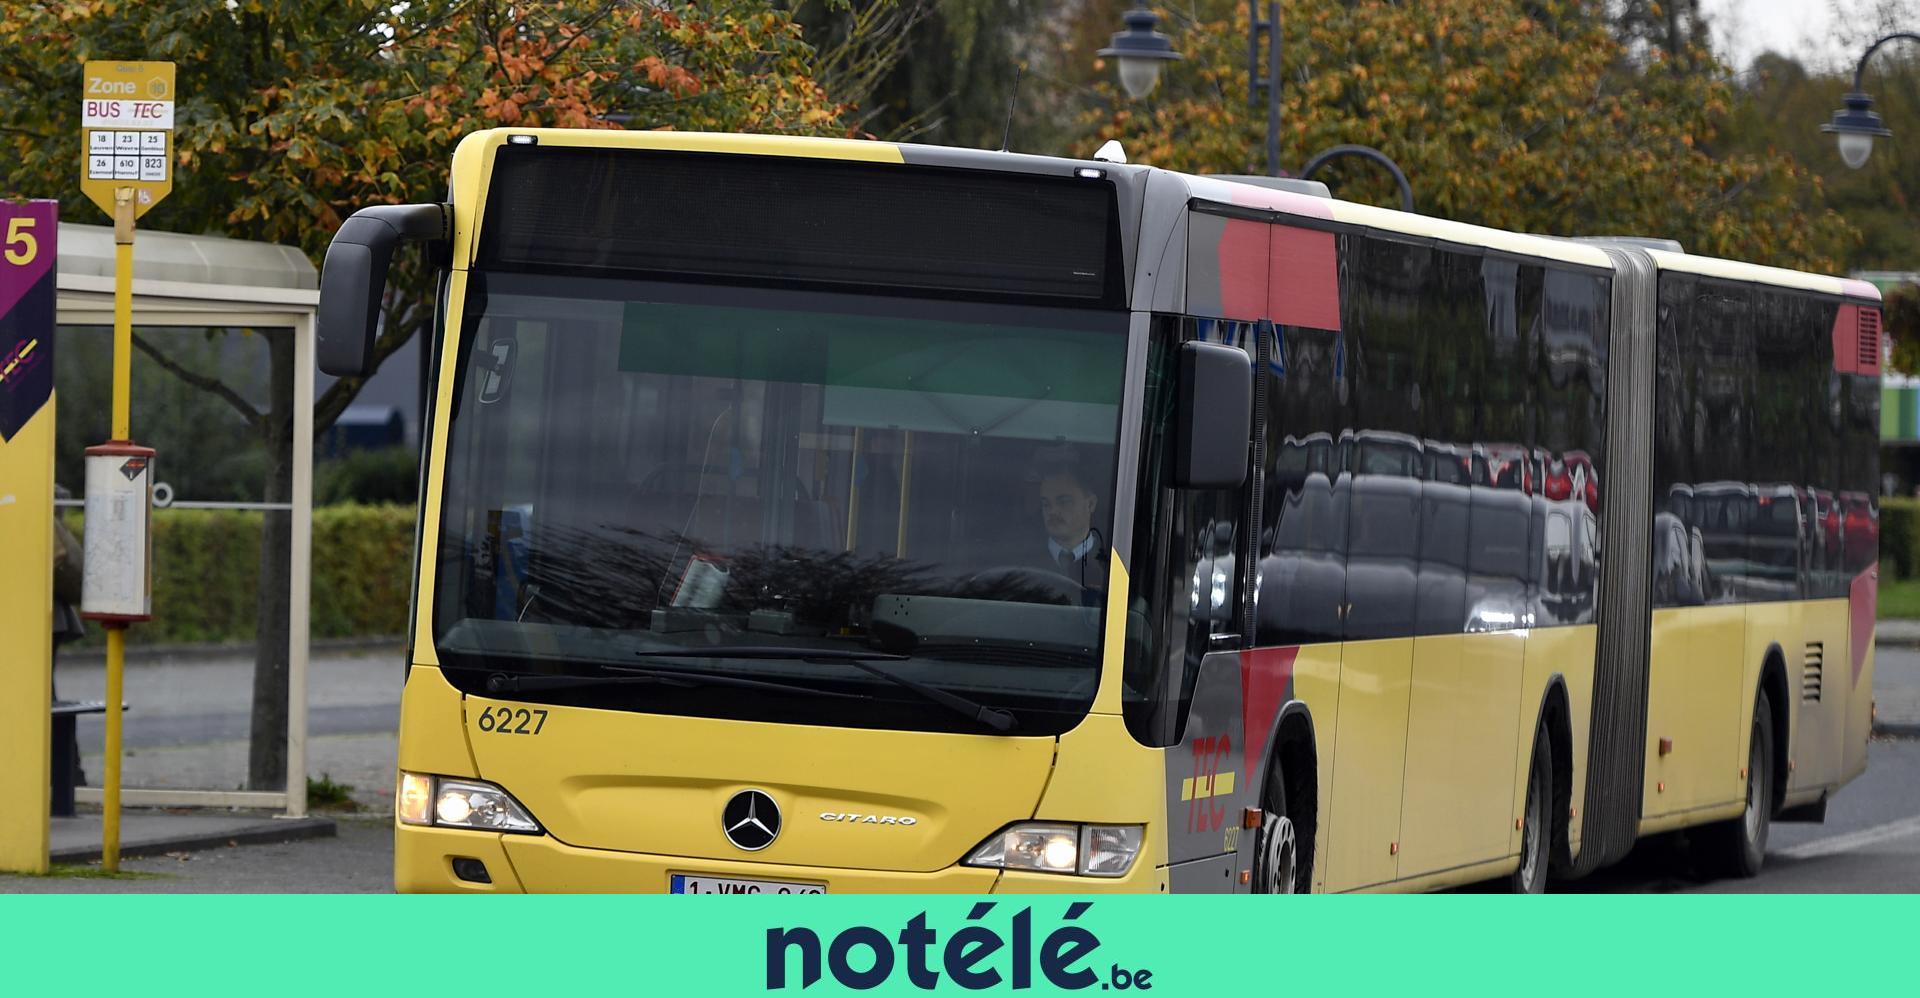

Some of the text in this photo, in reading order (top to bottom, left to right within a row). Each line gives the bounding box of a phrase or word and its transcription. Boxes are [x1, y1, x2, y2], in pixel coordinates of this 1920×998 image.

[88, 77, 136, 93] Zone
[87, 101, 164, 118] BUS TEC
[98, 135, 106, 143] 18
[122, 135, 132, 143] 23
[148, 135, 158, 143] 25
[96, 159, 106, 167] 26
[145, 158, 162, 169] 823
[4, 217, 38, 266] 5
[478, 706, 549, 735] 6227
[1183, 733, 1233, 833] TEC
[819, 811, 918, 827] CITARO
[1223, 826, 1240, 853] 6227
